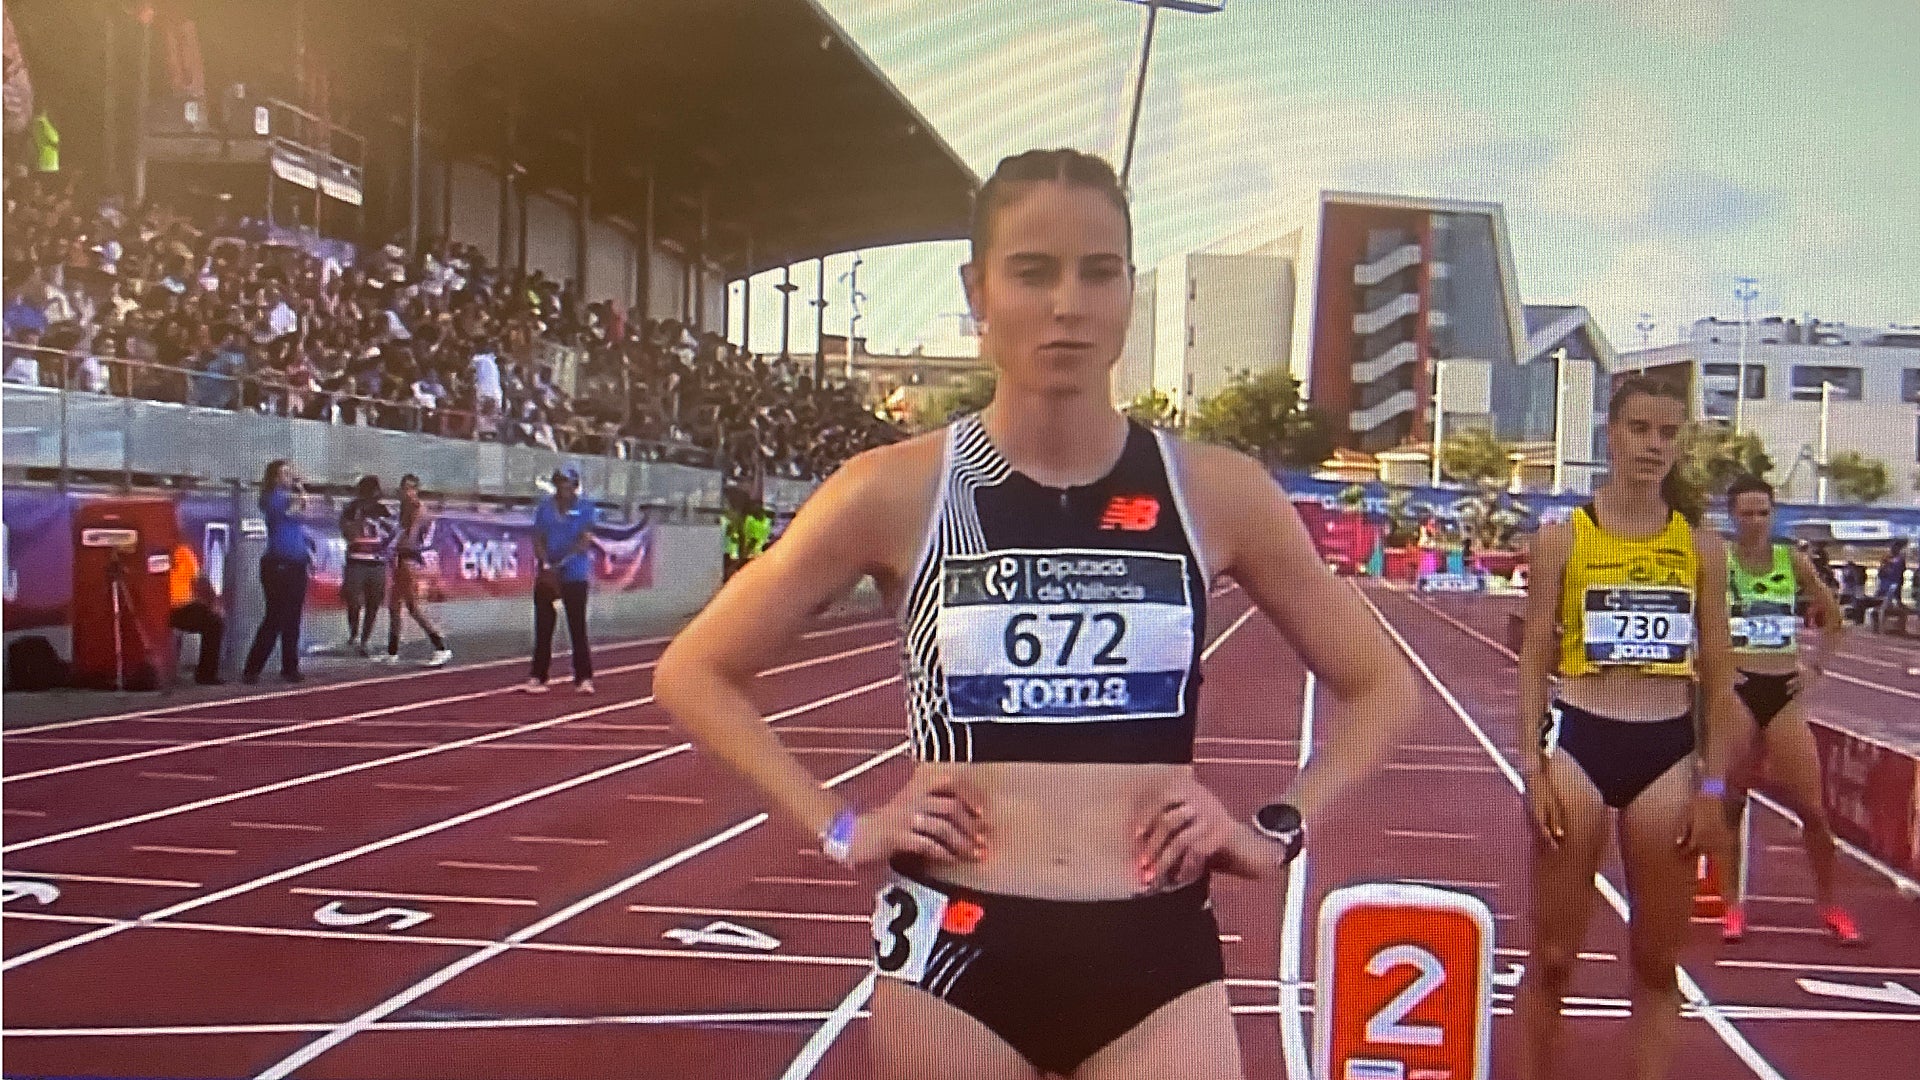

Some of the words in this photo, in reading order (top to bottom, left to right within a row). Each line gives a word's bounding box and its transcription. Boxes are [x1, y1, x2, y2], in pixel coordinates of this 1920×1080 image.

[1003, 612, 1128, 668] 672
[1612, 615, 1669, 640] 730
[313, 901, 434, 930] 5
[662, 921, 782, 950] 4
[875, 887, 918, 971] 3
[1364, 944, 1447, 1046] 2
